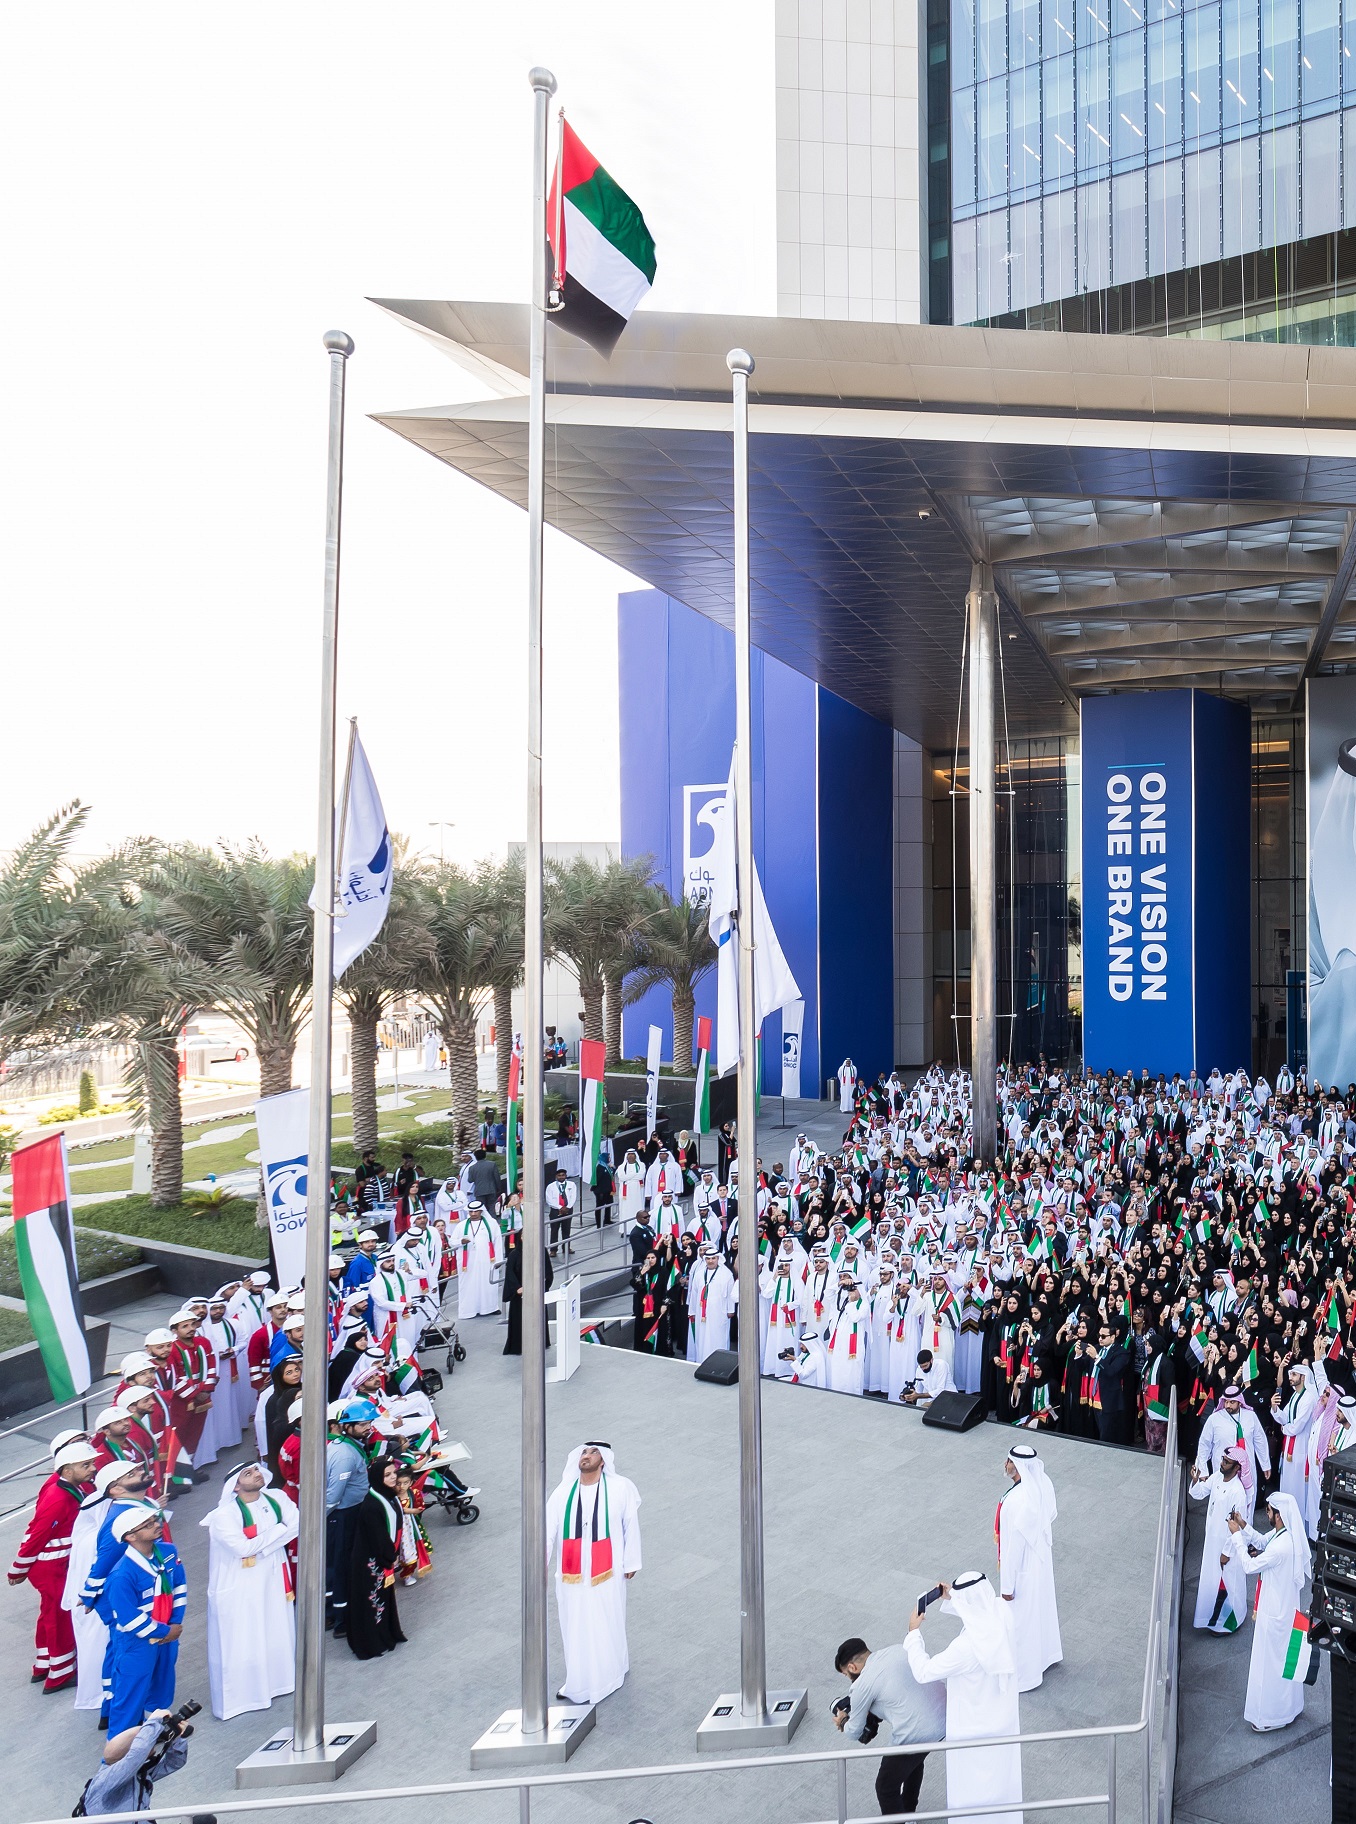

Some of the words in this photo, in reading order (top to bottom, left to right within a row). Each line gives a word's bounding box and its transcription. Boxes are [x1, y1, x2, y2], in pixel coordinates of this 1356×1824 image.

[1107, 774, 1133, 856] ONE
[1139, 772, 1167, 855] ONE
[1107, 865, 1134, 1002] BRAND
[1140, 863, 1168, 1001] VISION
